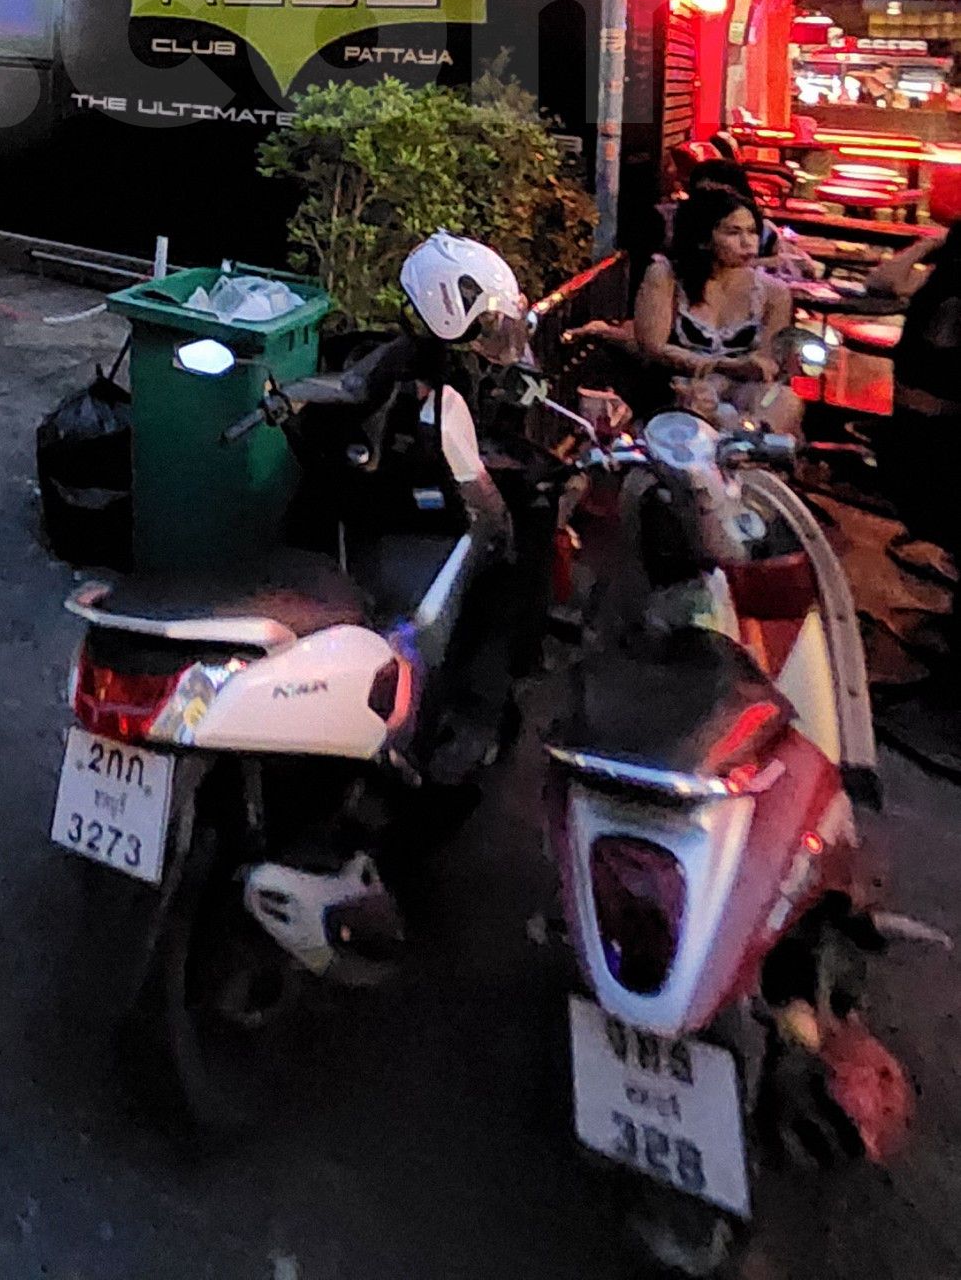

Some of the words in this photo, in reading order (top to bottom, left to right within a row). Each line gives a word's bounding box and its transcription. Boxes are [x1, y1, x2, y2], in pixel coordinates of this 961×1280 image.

[150, 38, 237, 56] CLUB
[344, 45, 453, 66] PATTAYA
[71, 92, 128, 112] THE
[138, 98, 299, 128] ULTIMATE
[68, 812, 142, 867] 3273
